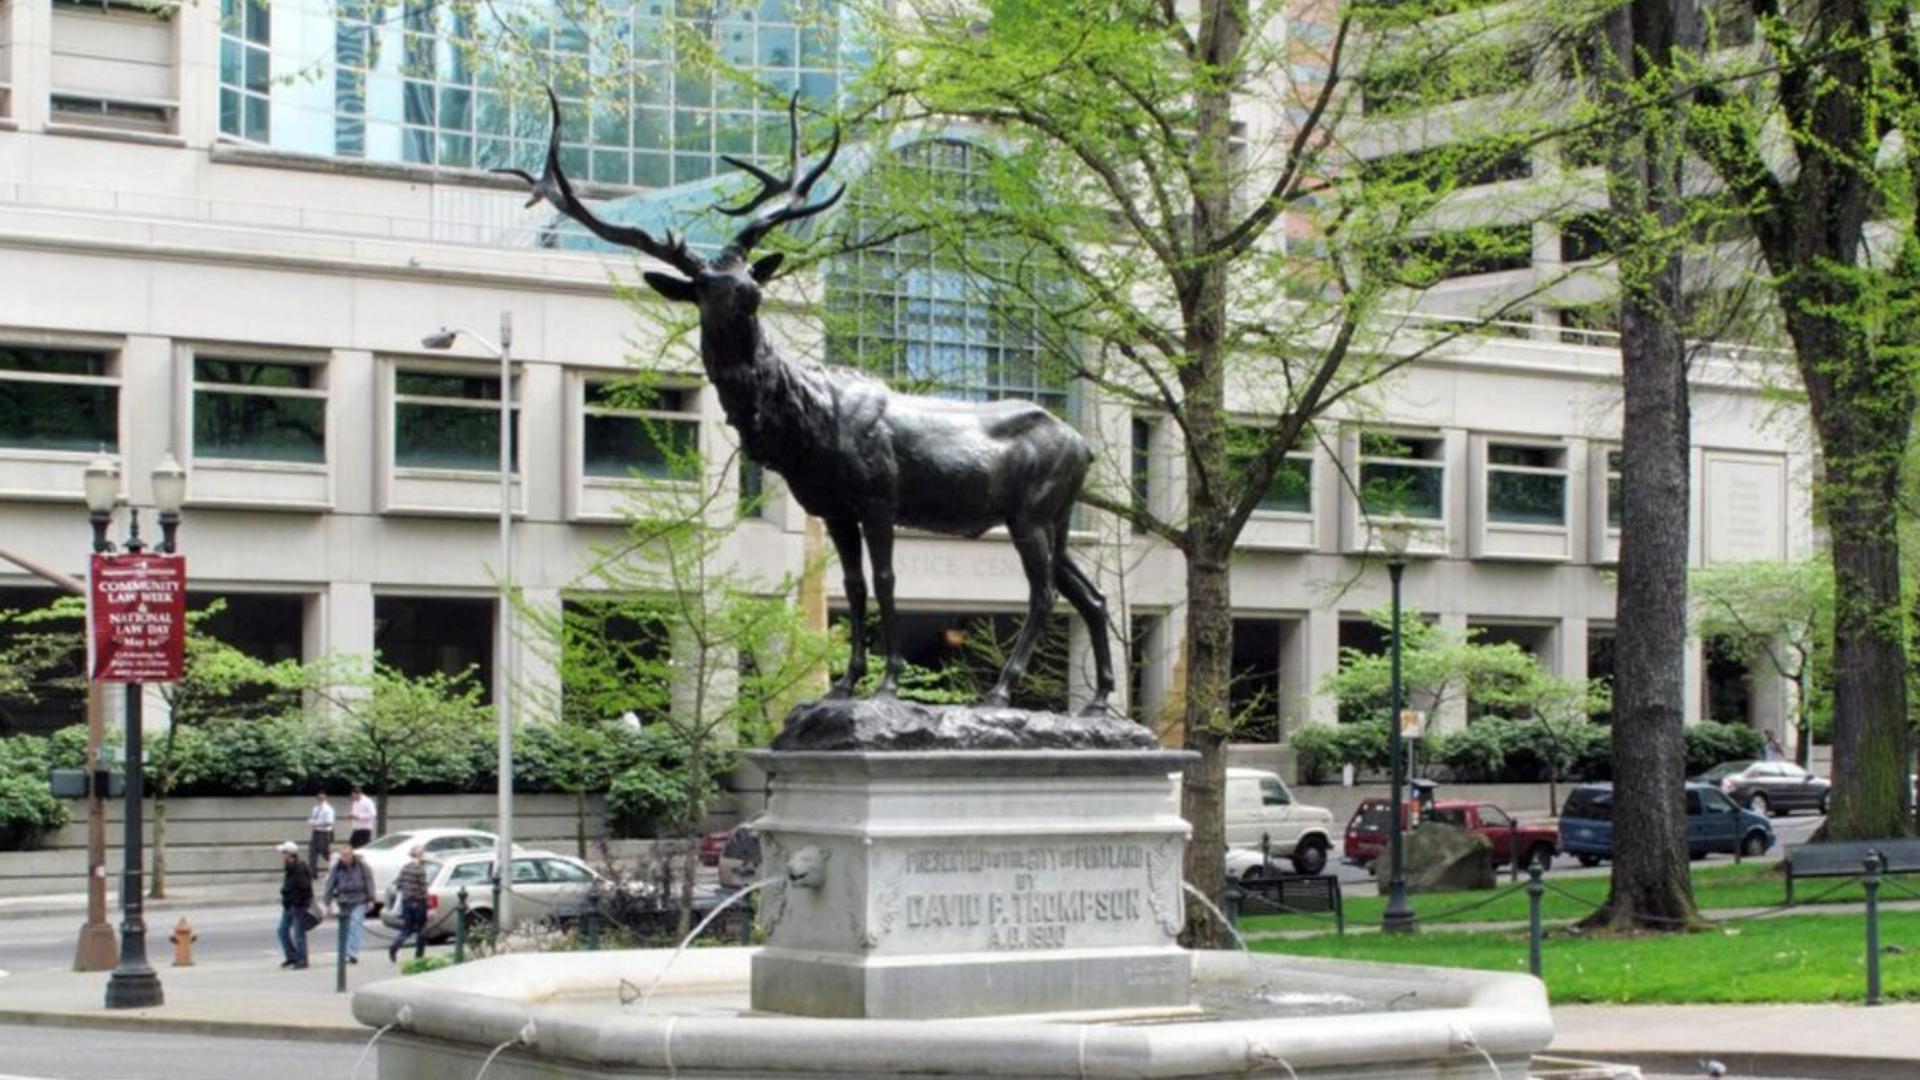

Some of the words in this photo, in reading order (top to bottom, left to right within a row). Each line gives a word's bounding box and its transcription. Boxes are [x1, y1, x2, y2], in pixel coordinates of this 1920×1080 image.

[896, 555, 960, 577] STICE
[99, 581, 178, 592] COMMUNITY
[108, 593, 136, 603] LAW
[140, 593, 174, 603] WEEK
[109, 613, 172, 624] NATIONAL
[116, 625, 142, 634] LAW
[148, 625, 170, 634] DAY
[905, 850, 985, 875] PRESENTED
[906, 894, 981, 929] DAVID
[1011, 888, 1140, 925] THOMPSON
